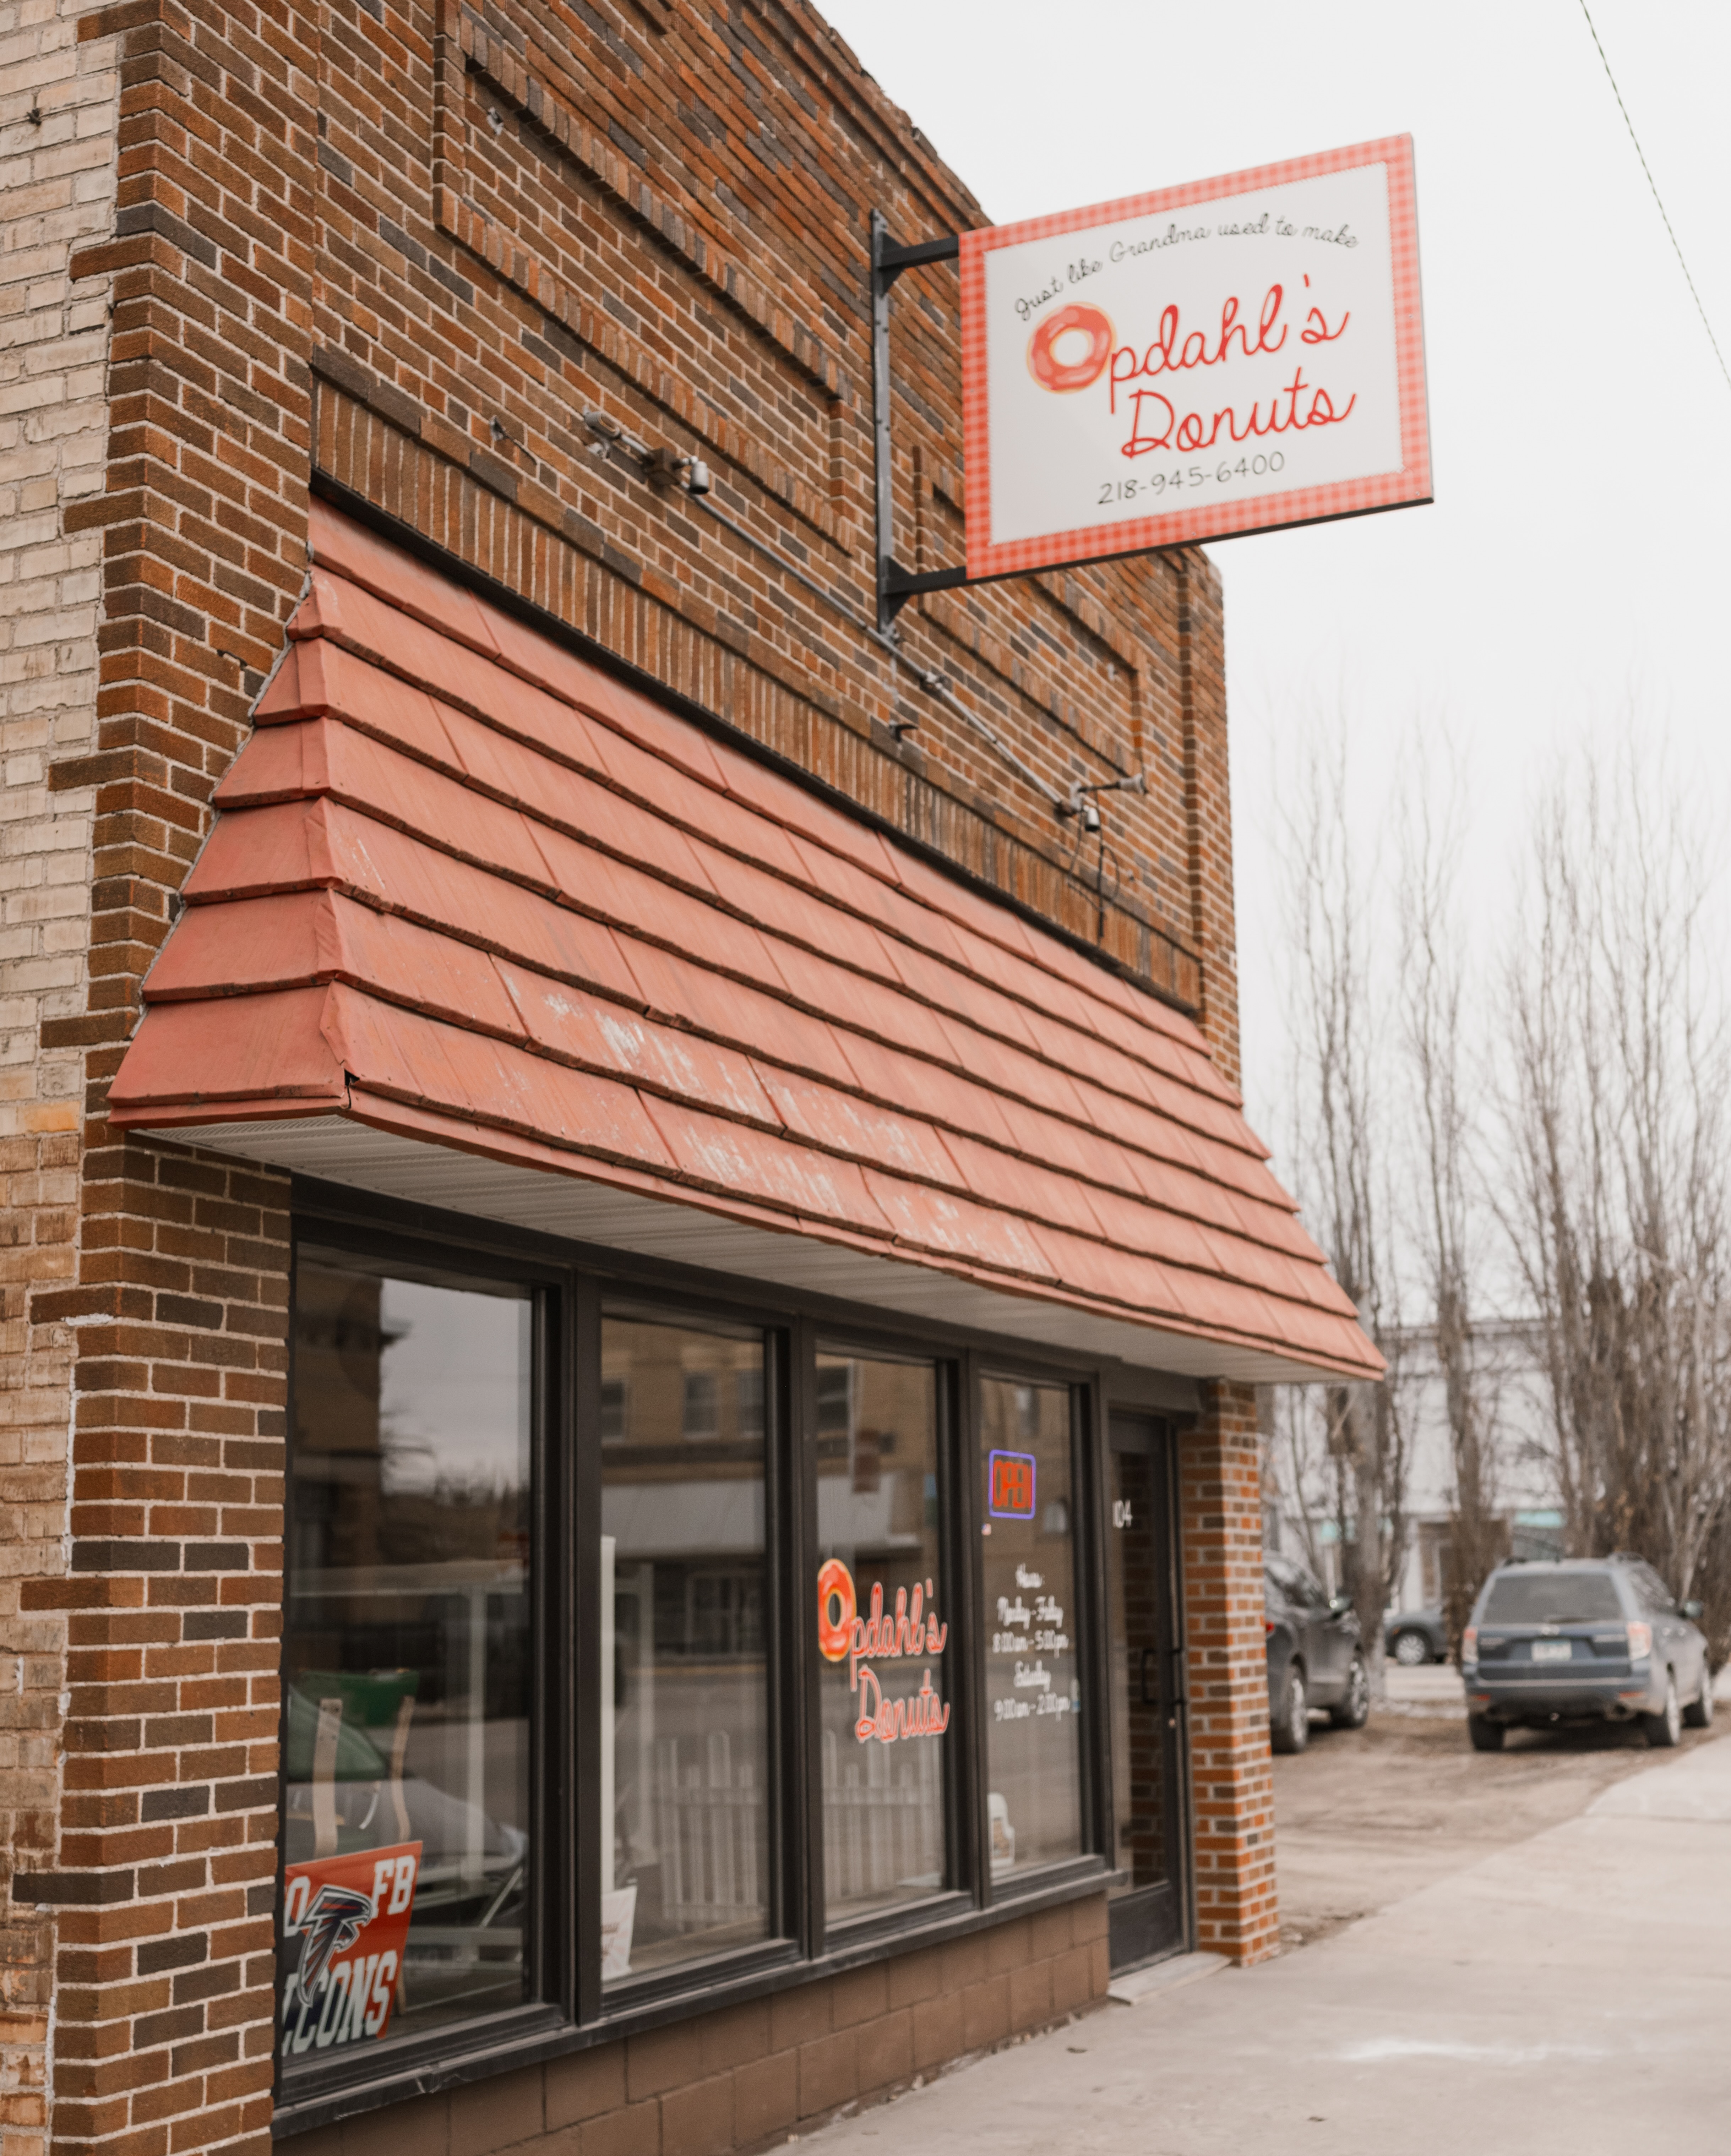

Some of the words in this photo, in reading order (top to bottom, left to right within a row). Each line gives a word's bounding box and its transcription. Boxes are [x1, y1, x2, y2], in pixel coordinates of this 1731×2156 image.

[1015, 277, 1063, 321] Just
[1067, 258, 1102, 283] like
[1109, 223, 1210, 262] Grandma
[1218, 213, 1270, 236] used
[1276, 215, 1297, 236] to
[1302, 224, 1359, 248] make
[1027, 273, 1350, 414] Opdahl's
[1121, 366, 1356, 458] Donuts
[1097, 451, 1284, 504] 218-945-6400
[993, 1460, 1033, 1508] OPEN
[1112, 1499, 1133, 1528] 104
[818, 1559, 947, 1691] Opdahl's
[856, 1665, 950, 1743] Donuts
[371, 1855, 416, 1918] FB
